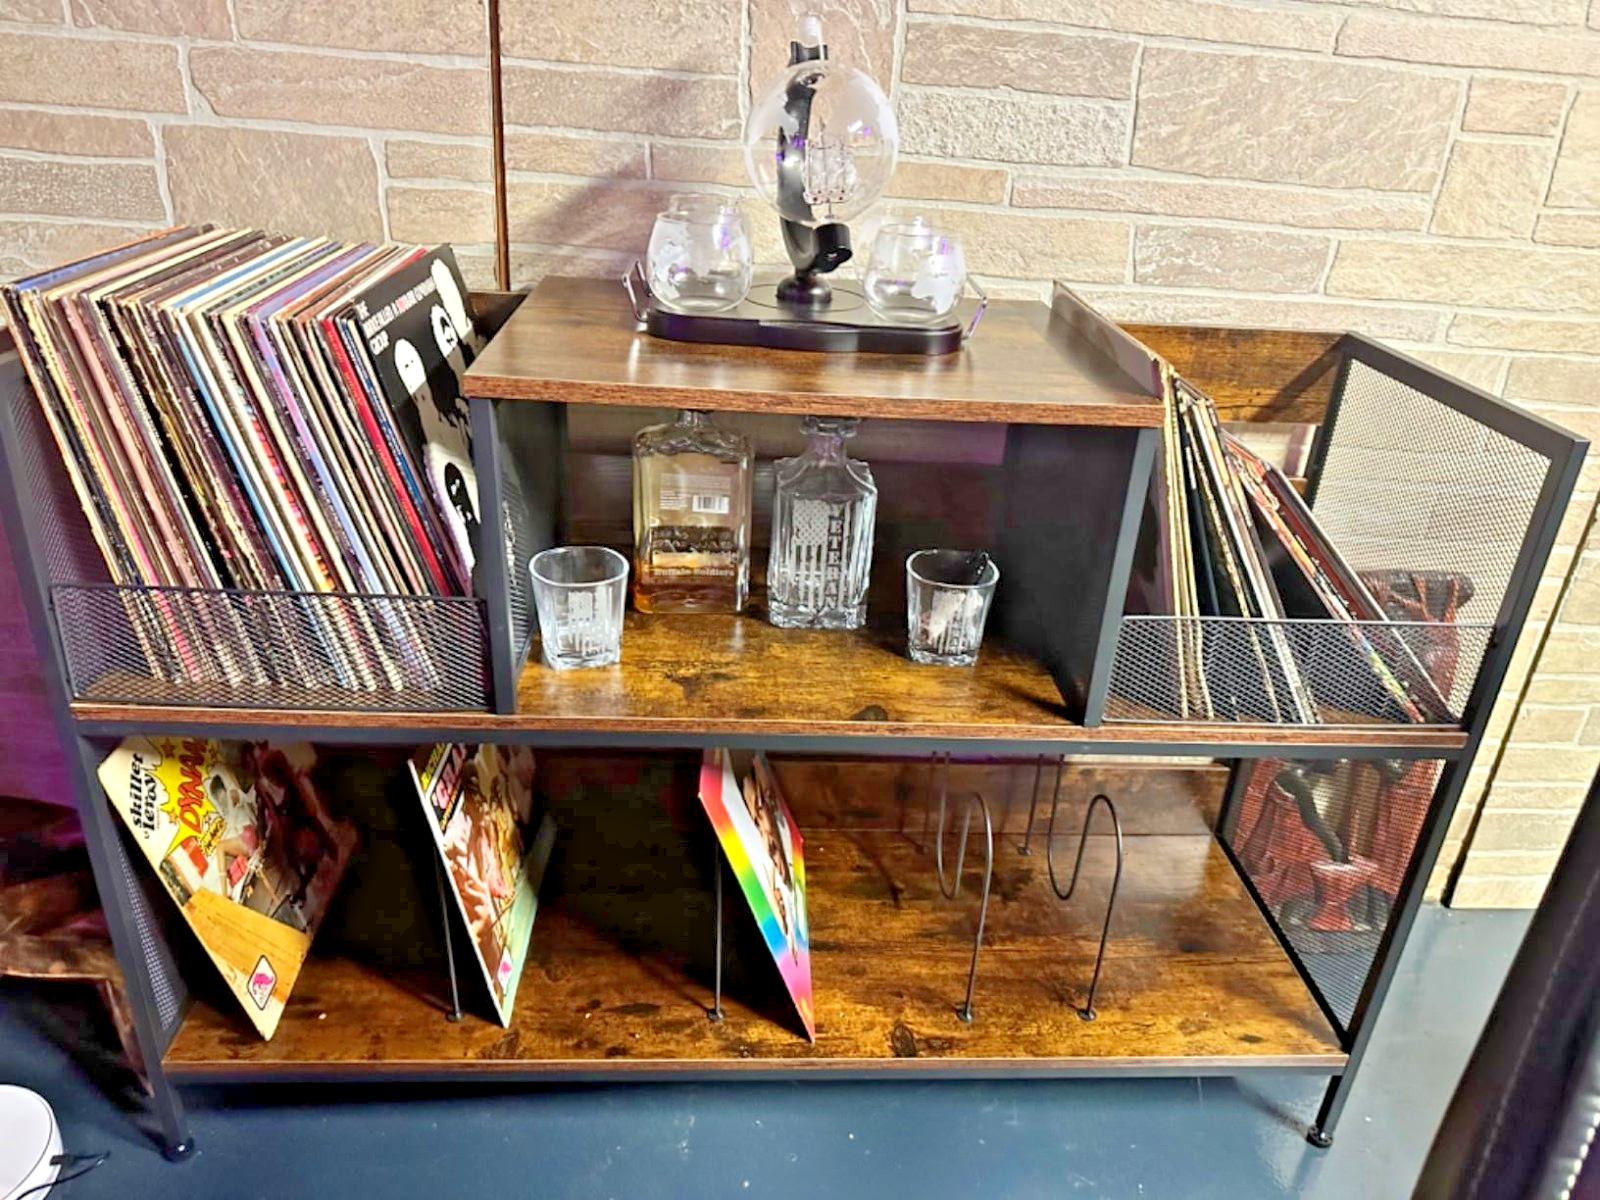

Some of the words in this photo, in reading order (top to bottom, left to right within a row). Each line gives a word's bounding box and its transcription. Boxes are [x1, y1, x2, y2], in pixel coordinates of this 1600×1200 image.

[825, 503, 844, 608] VETERAN
[130, 752, 144, 828] skillet
[142, 773, 157, 831] leroy
